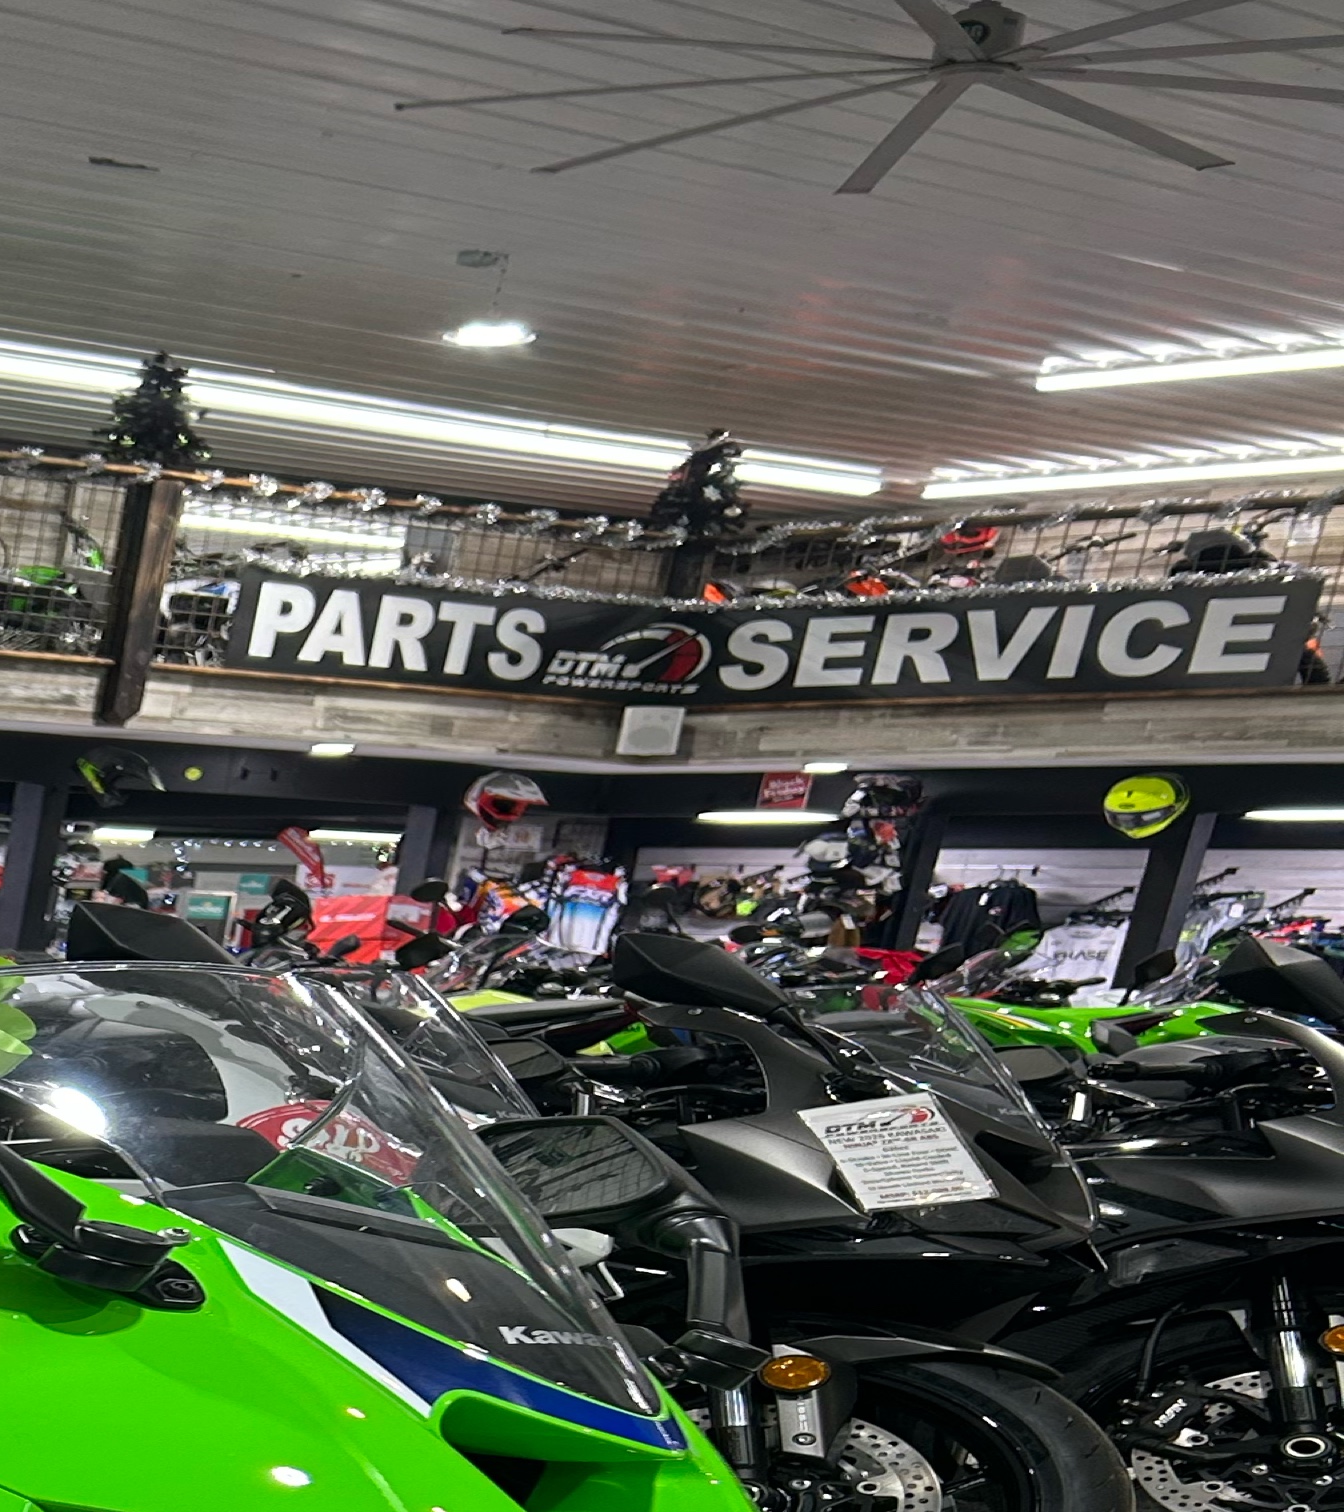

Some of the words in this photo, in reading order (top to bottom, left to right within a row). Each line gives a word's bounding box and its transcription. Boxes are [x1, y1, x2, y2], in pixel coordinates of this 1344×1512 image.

[248, 580, 547, 681] PARTS
[547, 649, 628, 678] DTM
[718, 597, 1287, 690] SERVICE
